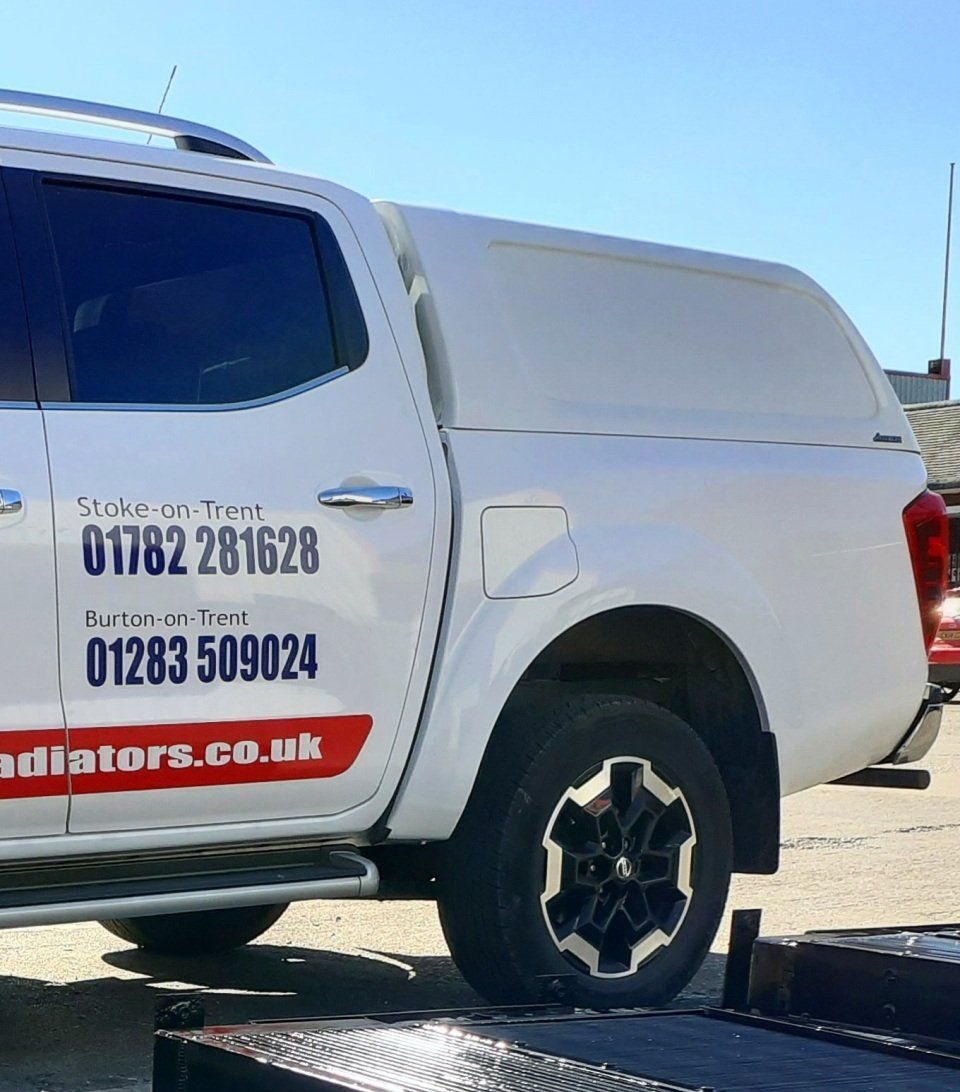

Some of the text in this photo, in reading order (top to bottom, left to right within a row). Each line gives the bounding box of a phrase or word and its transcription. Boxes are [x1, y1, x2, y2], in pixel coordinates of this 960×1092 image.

[77, 497, 265, 521] Stoke-on-Trent
[81, 524, 320, 576] 01782 281628
[85, 609, 249, 628] Burton-on-Trent
[86, 633, 318, 687] 01283 509024
